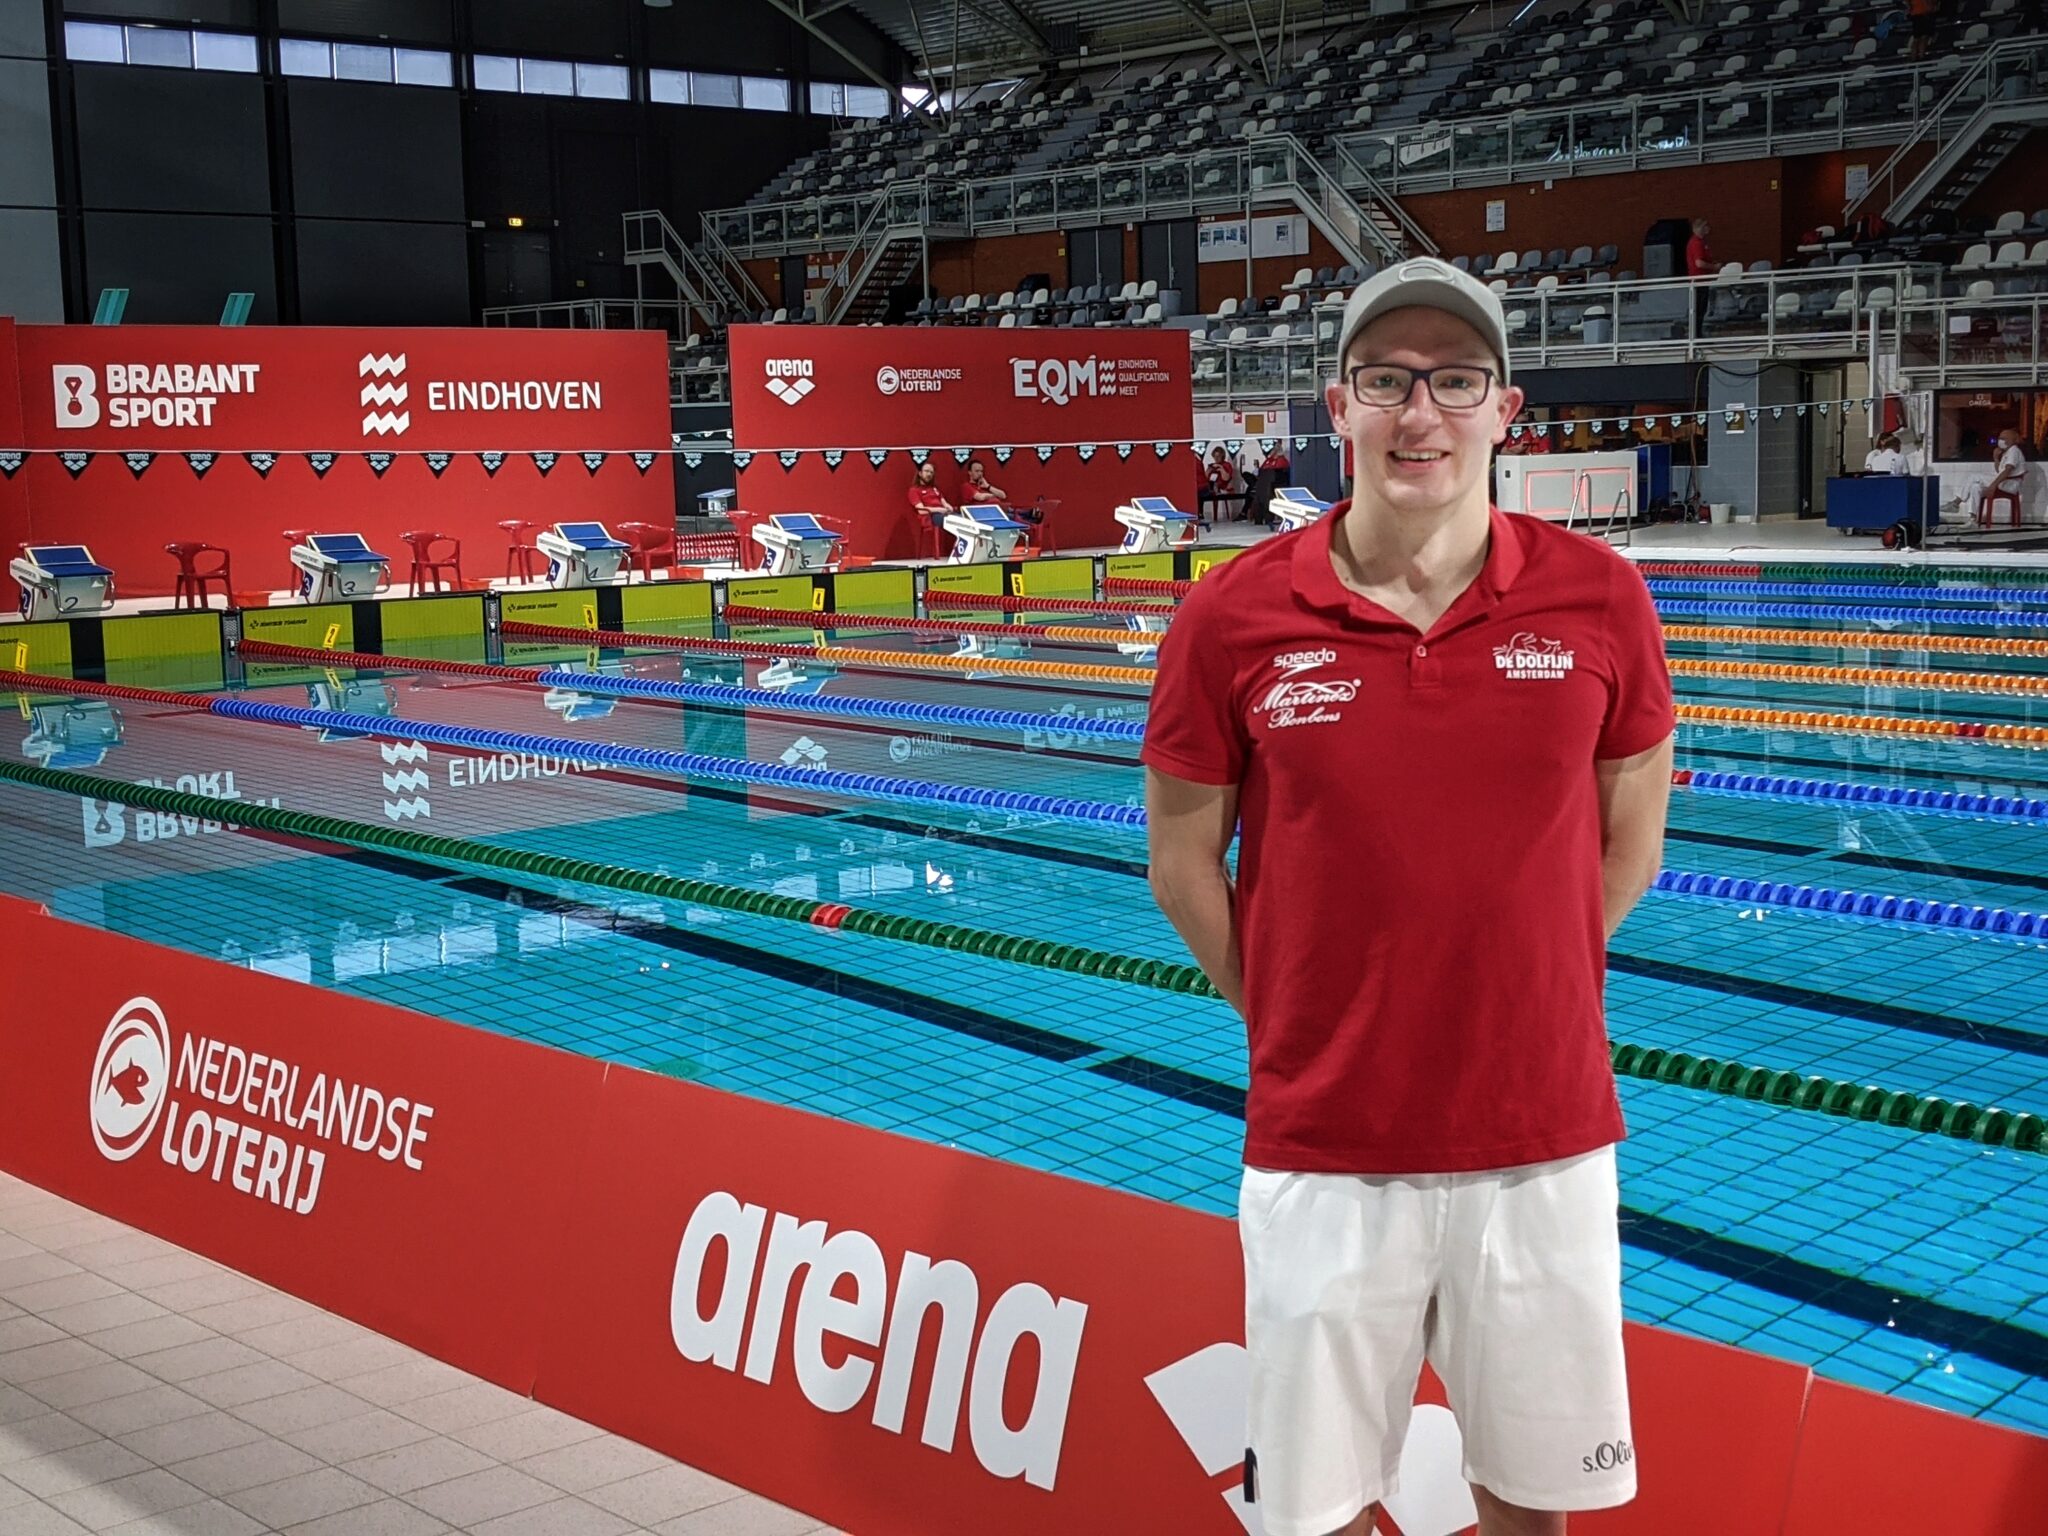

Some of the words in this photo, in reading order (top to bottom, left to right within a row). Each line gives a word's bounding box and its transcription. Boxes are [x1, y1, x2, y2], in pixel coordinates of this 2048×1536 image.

[765, 359, 813, 377] arena
[1117, 360, 1158, 369] EINDHOVEN
[106, 364, 260, 394] BRABANT
[900, 368, 962, 381] NEDERLANDSE
[1010, 357, 1098, 406] EQM
[1118, 372, 1169, 382] QUALIFICATION
[900, 380, 942, 392] LOTERIJ
[1119, 386, 1138, 396] MEET
[427, 381, 602, 411] EINDHOVEN
[109, 397, 217, 427] SPORT
[958, 541, 964, 555] 6
[766, 552, 773, 567] 5
[550, 564, 556, 578] 4
[304, 576, 311, 593] 3
[1014, 577, 1021, 592] 5
[22, 593, 29, 610] 2
[816, 593, 821, 606] 4
[587, 609, 593, 624] 3
[327, 628, 336, 643] 2
[1273, 647, 1336, 669] speedo
[1495, 654, 1514, 669] DE
[1515, 654, 1574, 669] DOLFIJN
[1506, 670, 1565, 679] AMSTERDAM
[1268, 706, 1341, 729] Bonbons
[174, 1031, 435, 1171] NEDERLANDSE
[160, 1100, 326, 1215] LOTERIJ
[670, 1190, 1089, 1492] arena
